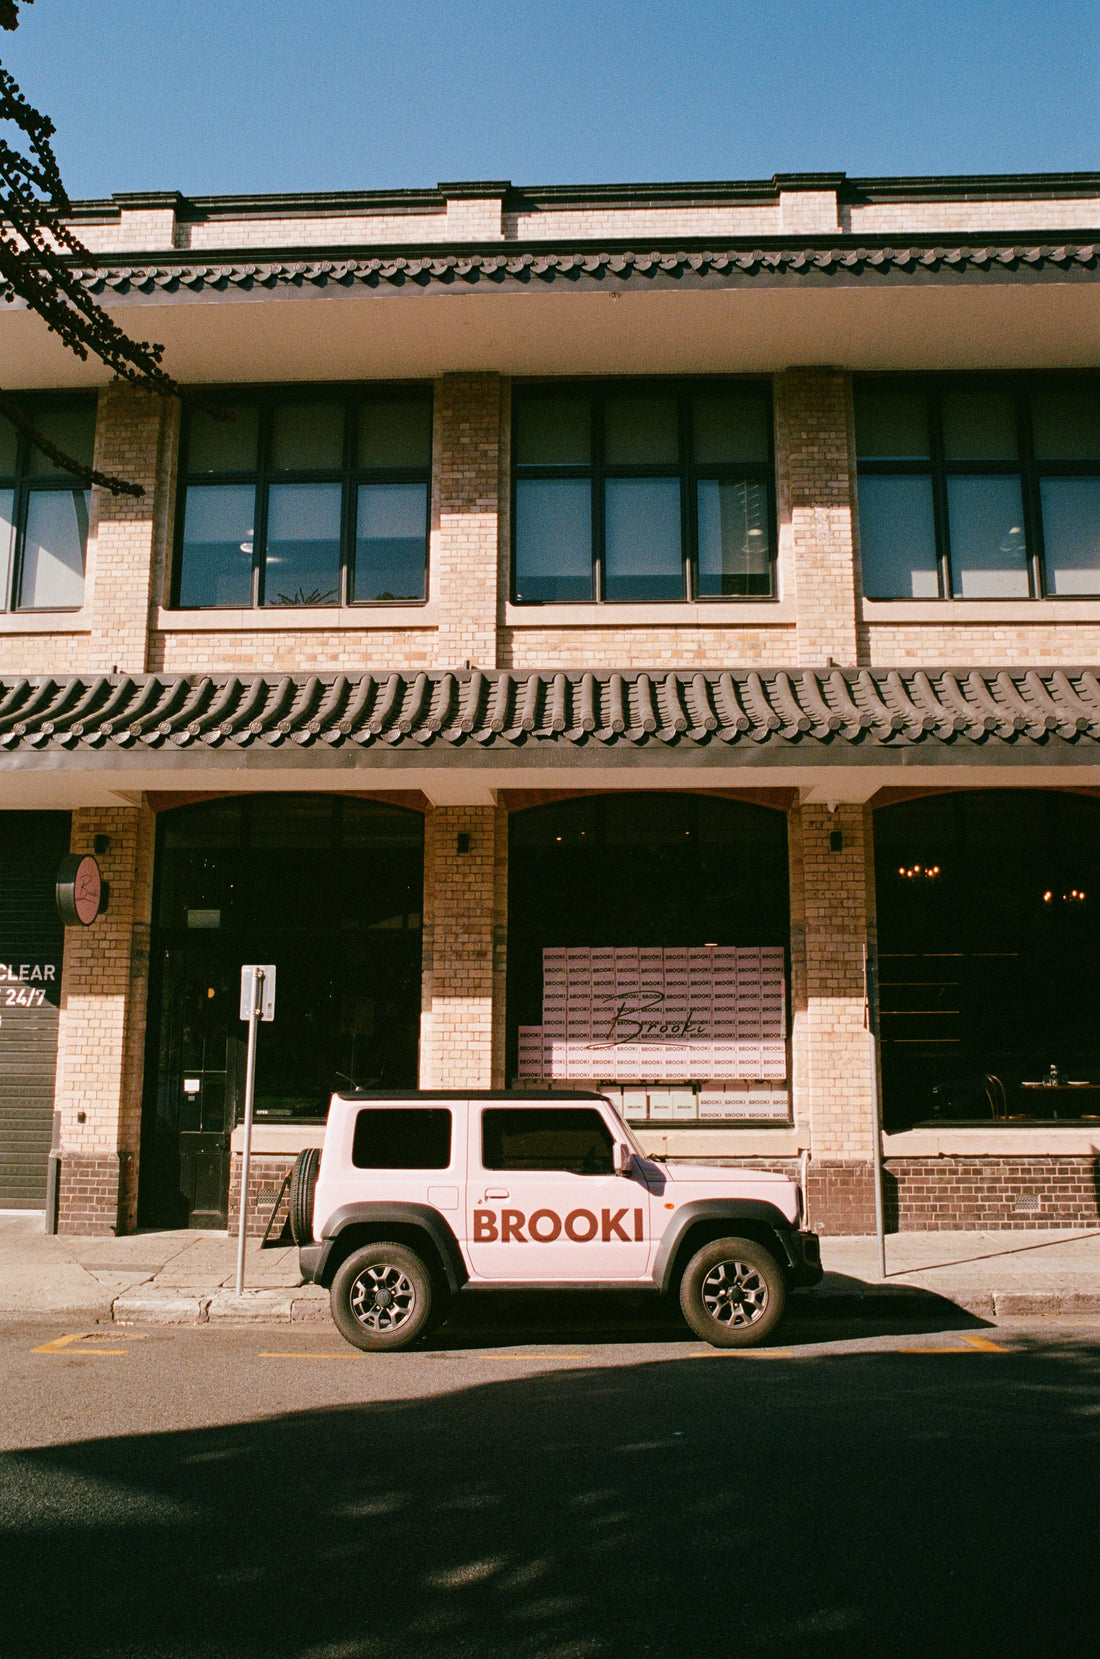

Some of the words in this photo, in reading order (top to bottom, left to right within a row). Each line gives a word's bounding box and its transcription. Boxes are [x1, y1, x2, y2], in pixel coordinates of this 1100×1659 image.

[0, 964, 56, 980] CLEAR
[6, 988, 46, 1006] 24/7
[586, 990, 706, 1050] Brooki
[473, 1208, 644, 1243] BROOKI
